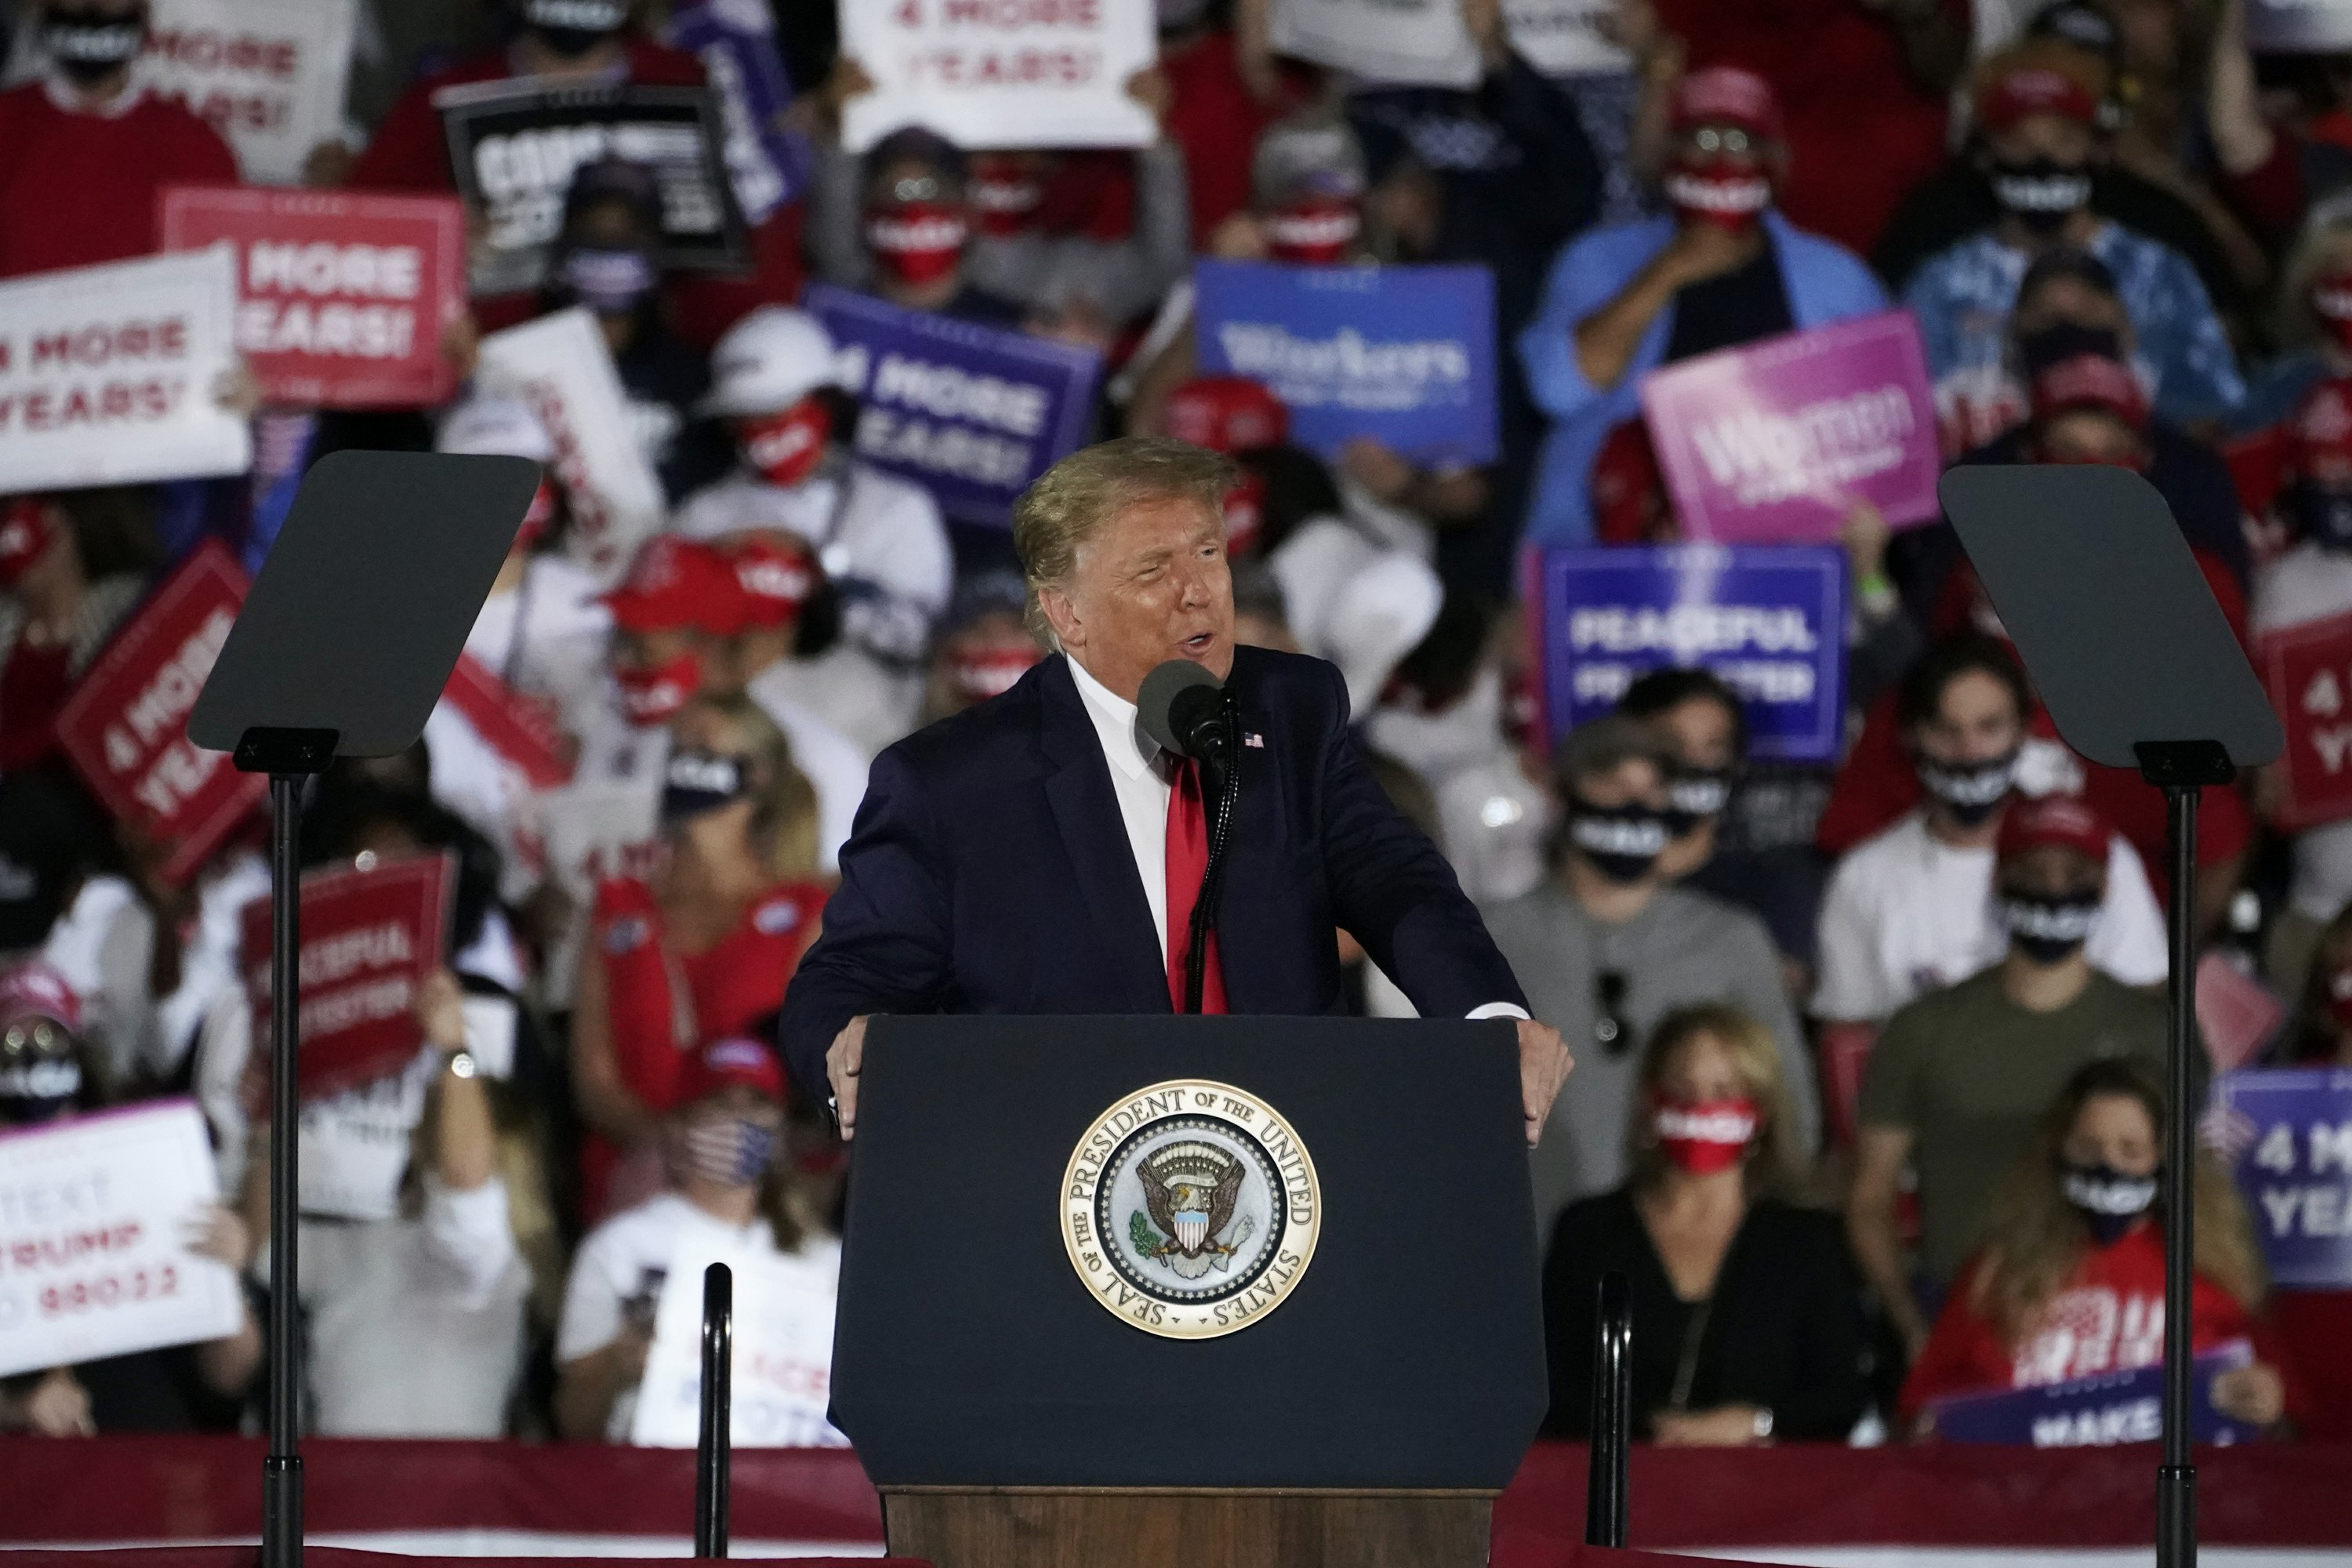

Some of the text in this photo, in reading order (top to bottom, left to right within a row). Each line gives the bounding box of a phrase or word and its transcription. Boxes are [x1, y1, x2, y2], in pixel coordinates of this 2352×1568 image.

[246, 240, 424, 299] MORE
[30, 318, 190, 373] MORE
[235, 299, 416, 360] EARS!
[872, 350, 1052, 439] MORE
[855, 403, 1035, 489] EARS!
[103, 724, 143, 773] 4
[1195, 1091, 1218, 1108] OF
[1223, 1097, 1255, 1123] THE
[1069, 1089, 1185, 1203] PRESIDENT
[1260, 1119, 1313, 1225] UNITED
[2253, 1121, 2296, 1174] 4
[0, 1220, 144, 1269] RUMP
[1073, 1211, 1092, 1247] THE
[1083, 1251, 1103, 1272] OF
[1213, 1249, 1301, 1327] STATES
[1101, 1272, 1167, 1326] SEAL
[2031, 1399, 2162, 1449] MAKE
